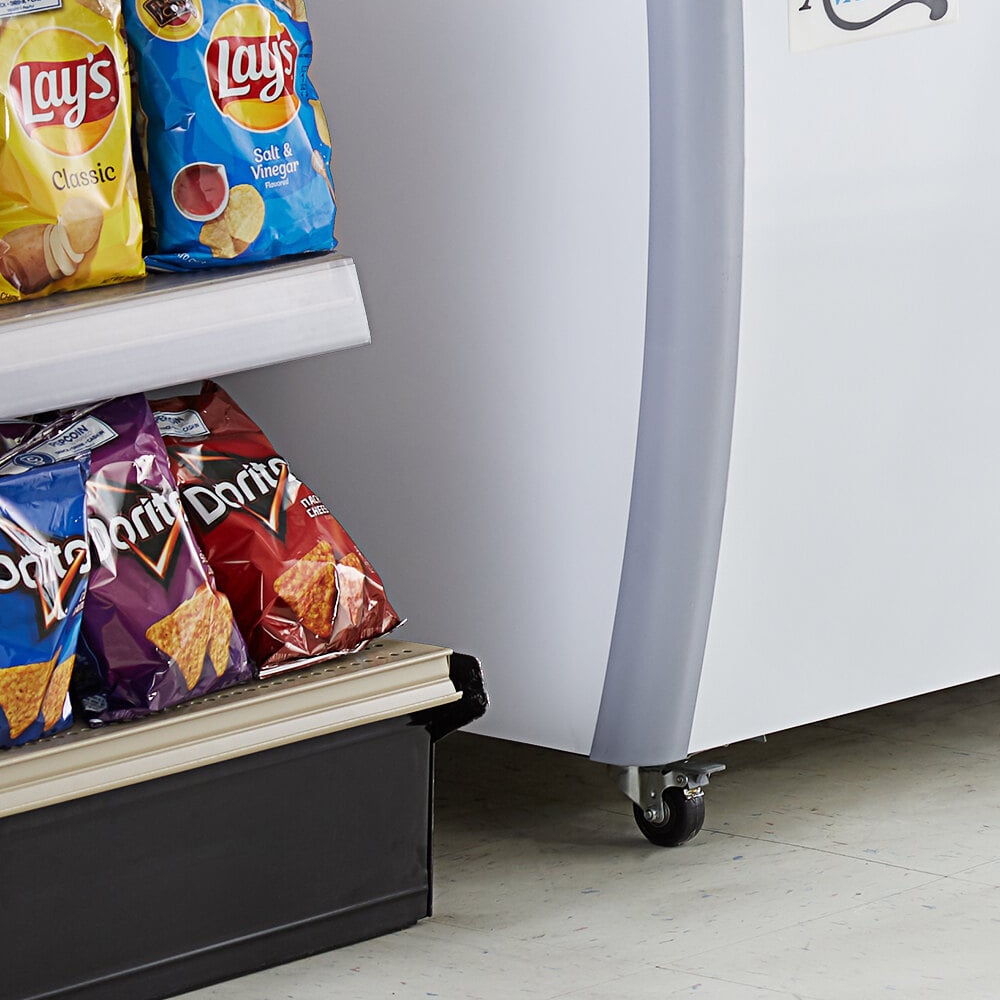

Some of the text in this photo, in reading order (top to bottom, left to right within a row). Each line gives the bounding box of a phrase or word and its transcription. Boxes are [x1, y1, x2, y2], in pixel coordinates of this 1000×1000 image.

[214, 31, 295, 103] Lay's
[19, 52, 112, 129] Lay's
[253, 142, 293, 163] Salt &
[52, 162, 117, 191] Classic
[250, 160, 299, 180] Vinegar
